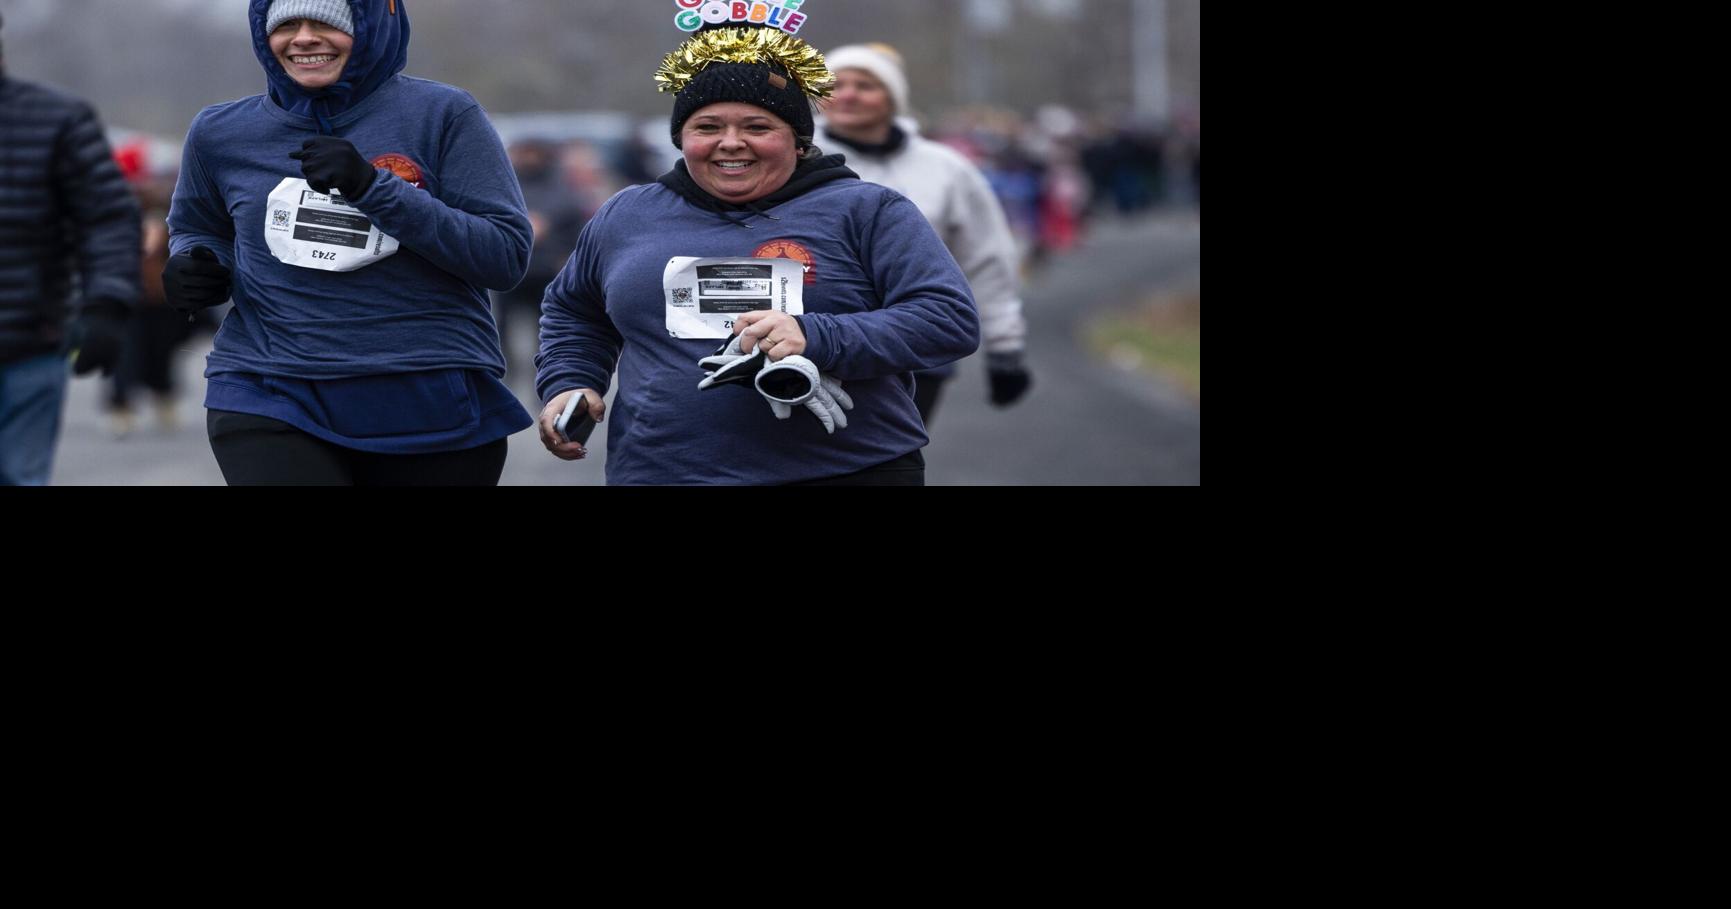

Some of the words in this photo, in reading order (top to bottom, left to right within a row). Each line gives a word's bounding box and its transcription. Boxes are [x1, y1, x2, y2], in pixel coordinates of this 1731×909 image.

[675, 1, 806, 33] GOBBLE
[312, 250, 337, 261] 2743
[724, 320, 735, 329] 42
